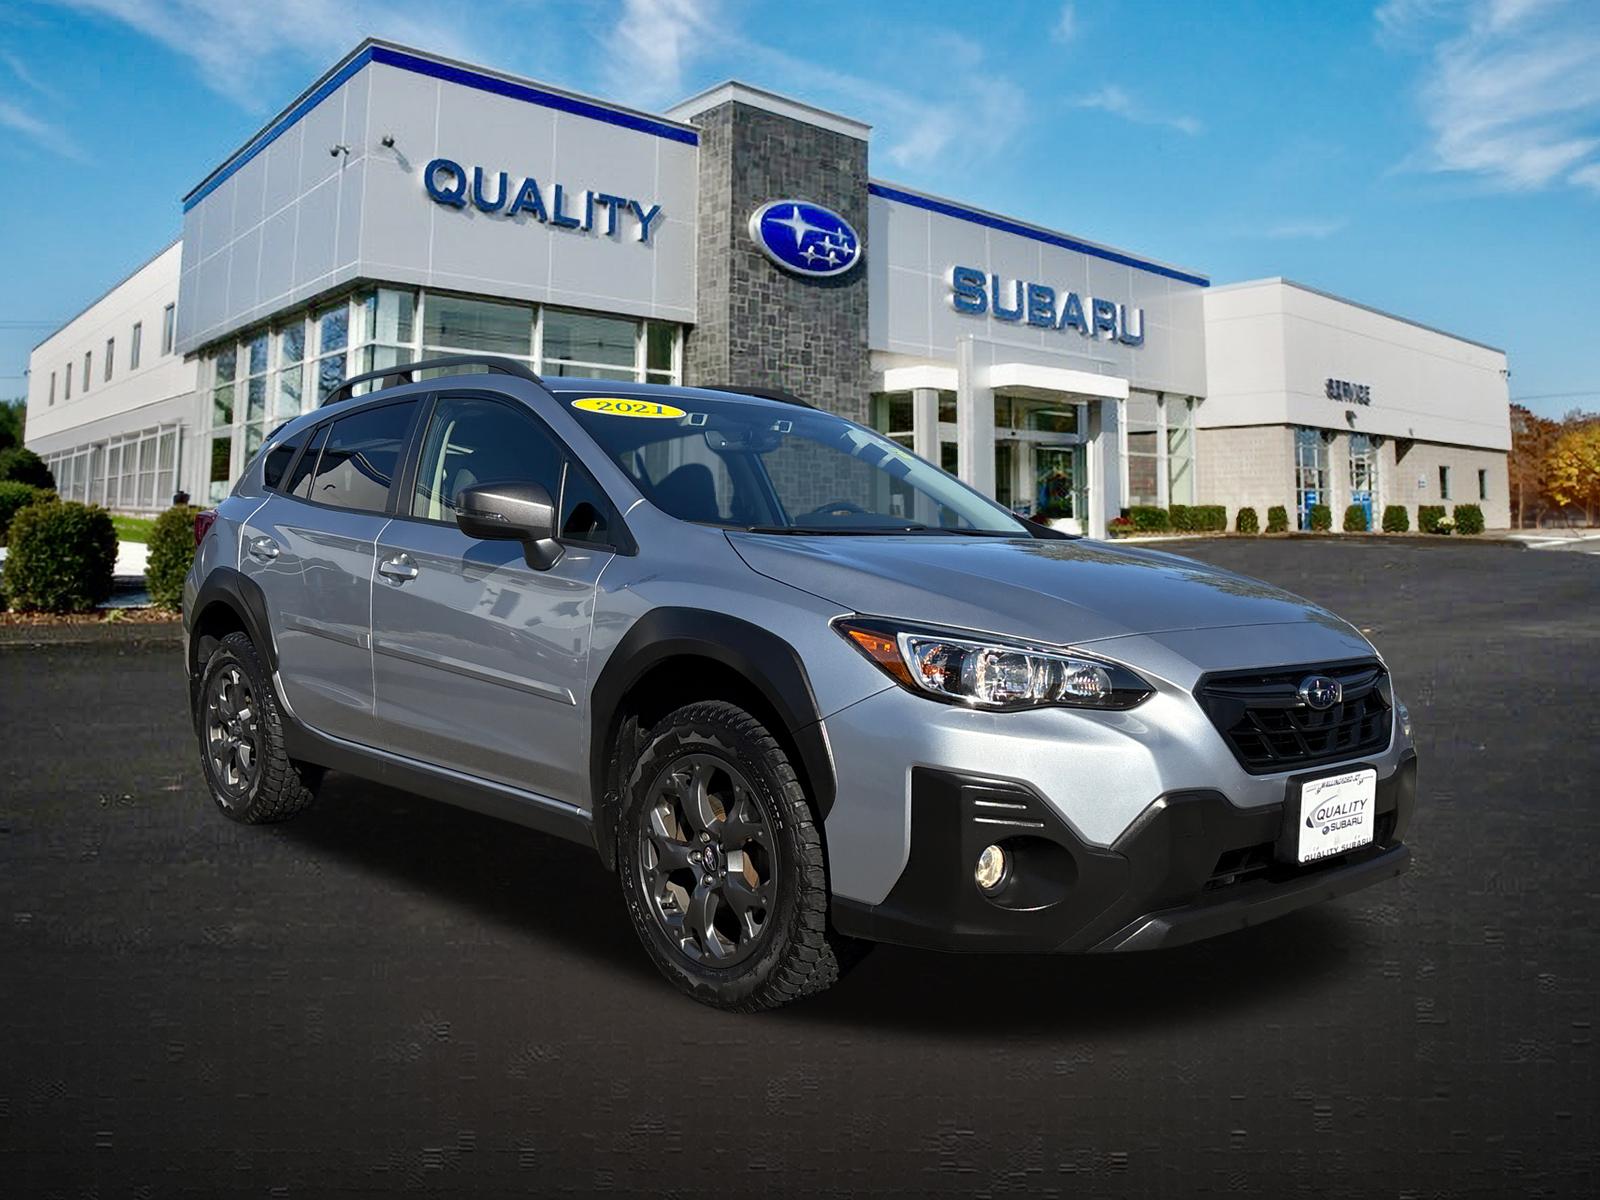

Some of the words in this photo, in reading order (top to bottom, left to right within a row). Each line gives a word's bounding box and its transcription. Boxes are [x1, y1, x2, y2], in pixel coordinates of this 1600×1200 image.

[424, 158, 662, 242] QUALITY
[951, 265, 1144, 347] SUBARU
[1325, 378, 1371, 407] SERVICE
[596, 400, 666, 415] 2021
[1316, 798, 1368, 821] QUALITY
[1330, 816, 1363, 832] SUBARU
[1303, 846, 1339, 861] QUALITY
